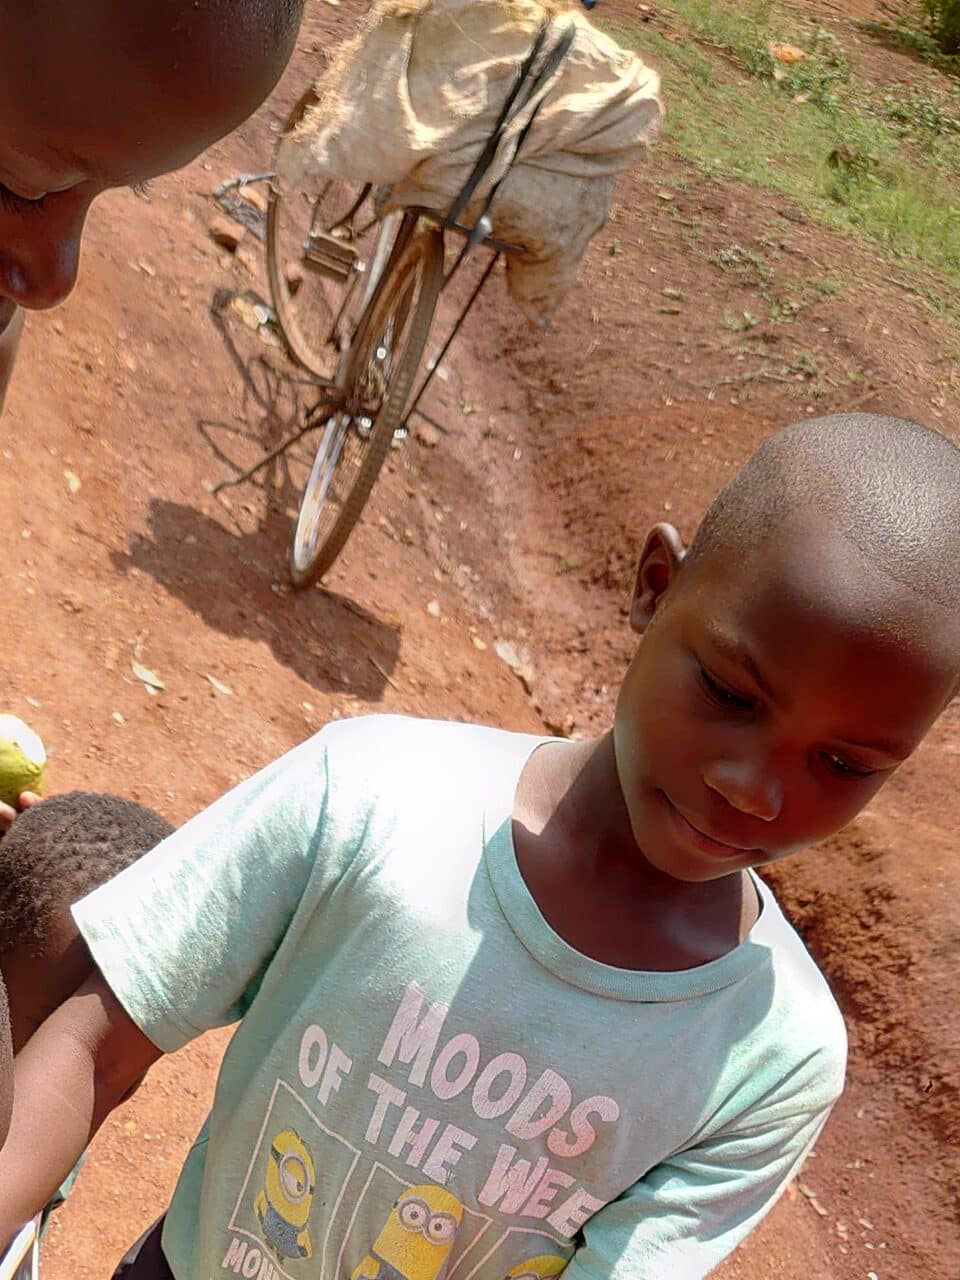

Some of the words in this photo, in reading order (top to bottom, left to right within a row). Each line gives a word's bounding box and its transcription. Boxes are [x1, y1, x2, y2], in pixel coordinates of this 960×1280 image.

[299, 1024, 352, 1106] OF
[365, 1074, 478, 1183] THE
[378, 981, 619, 1157] MOODS
